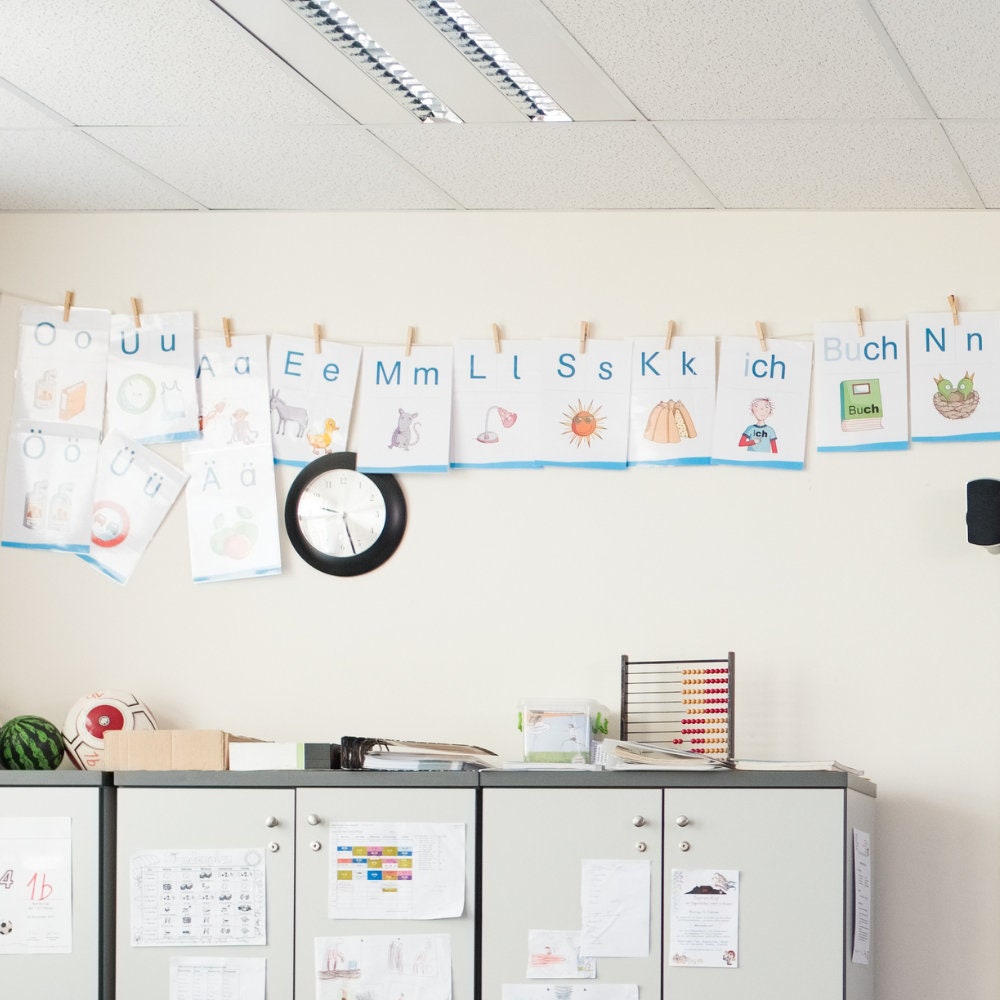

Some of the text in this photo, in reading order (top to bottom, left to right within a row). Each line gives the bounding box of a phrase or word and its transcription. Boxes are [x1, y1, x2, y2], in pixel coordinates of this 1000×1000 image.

[823, 336, 898, 361] Buch
[926, 328, 982, 352] N n
[284, 351, 339, 382] E e
[376, 361, 438, 385] M m
[557, 353, 612, 380] S s
[642, 351, 697, 376] K k
[744, 352, 786, 379] ich
[849, 404, 880, 415] Buch
[27, 873, 52, 901] 1b
